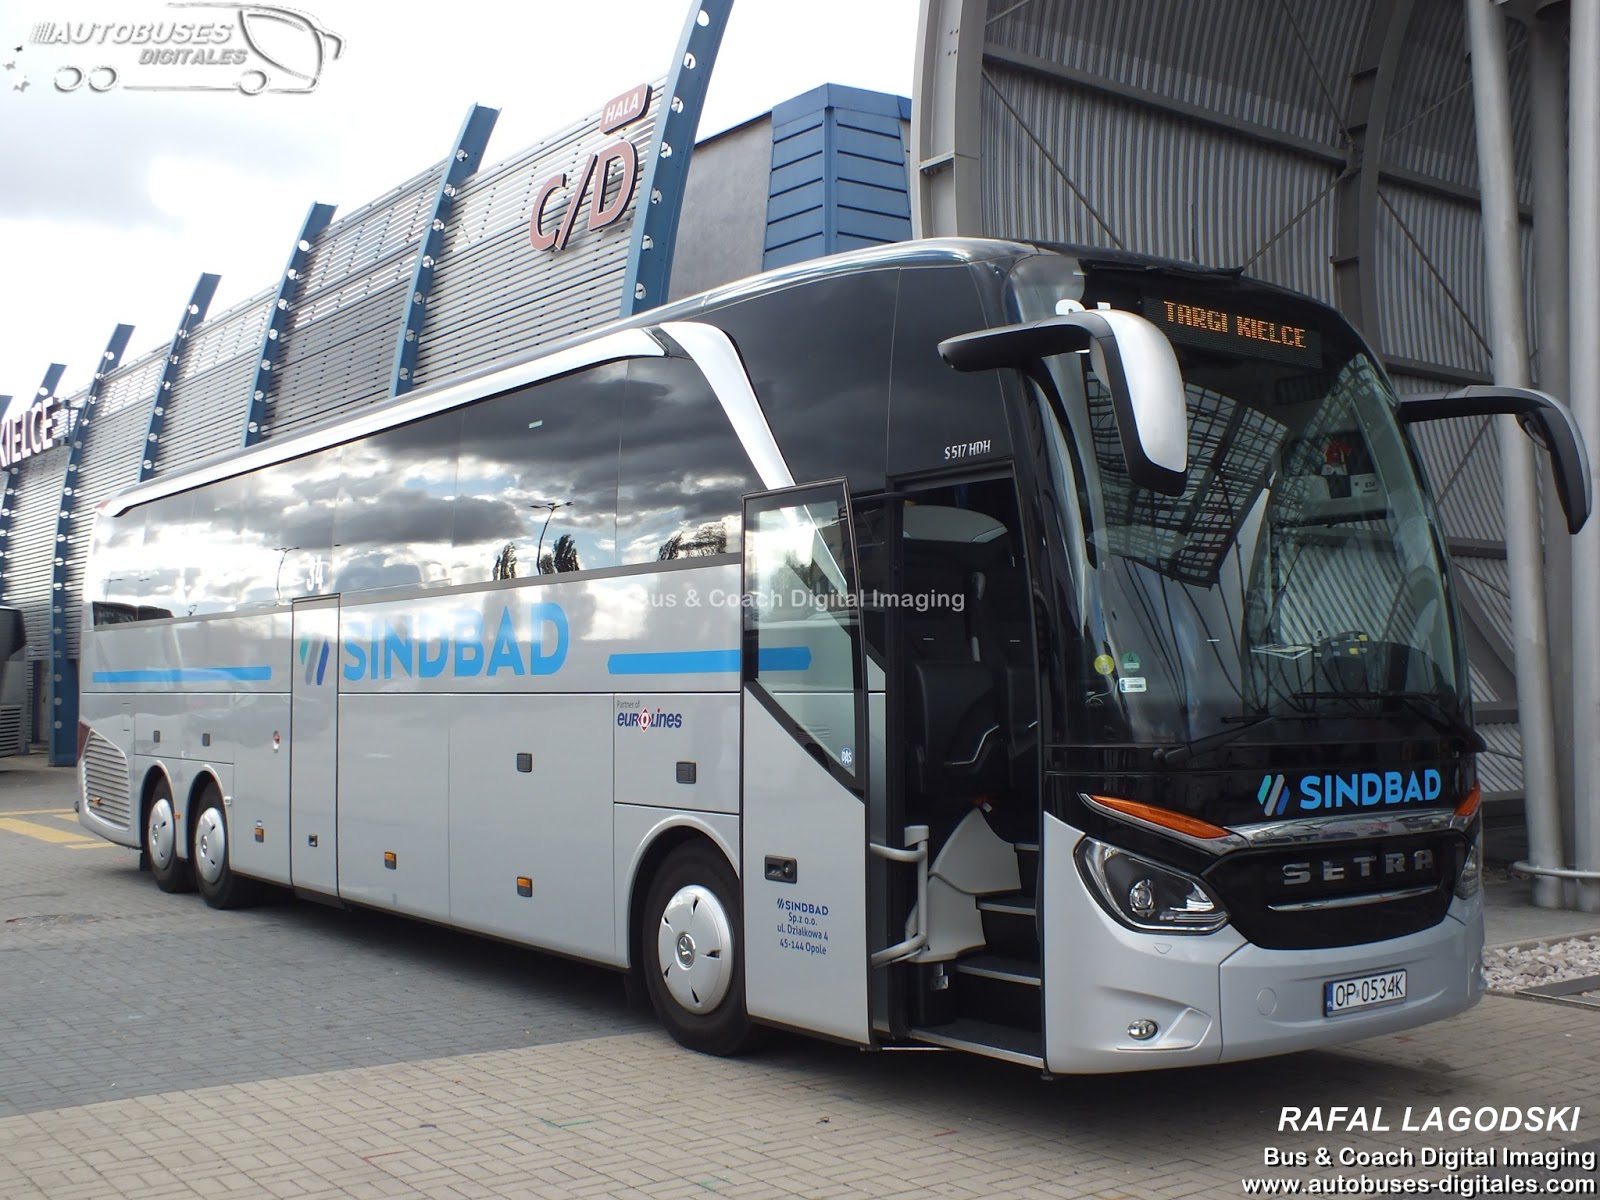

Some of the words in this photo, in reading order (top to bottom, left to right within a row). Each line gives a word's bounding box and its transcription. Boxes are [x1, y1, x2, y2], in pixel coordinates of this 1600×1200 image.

[604, 92, 639, 125] HALA
[529, 139, 638, 251] C/D
[1163, 300, 1228, 333] TARGI
[1236, 315, 1306, 349] KIELCE
[944, 446, 951, 460] S
[951, 443, 967, 459] 517
[969, 439, 991, 456] HDH
[342, 602, 570, 681] SINDBAD
[616, 700, 635, 708] Partner
[1299, 768, 1442, 810] SINDBAD
[1282, 848, 1436, 886] SETRA
[785, 900, 829, 916] SINDBAD
[777, 923, 786, 934] ul.
[780, 938, 804, 951] 45-144
[805, 941, 827, 956] Opole
[1335, 982, 1356, 1007] OP
